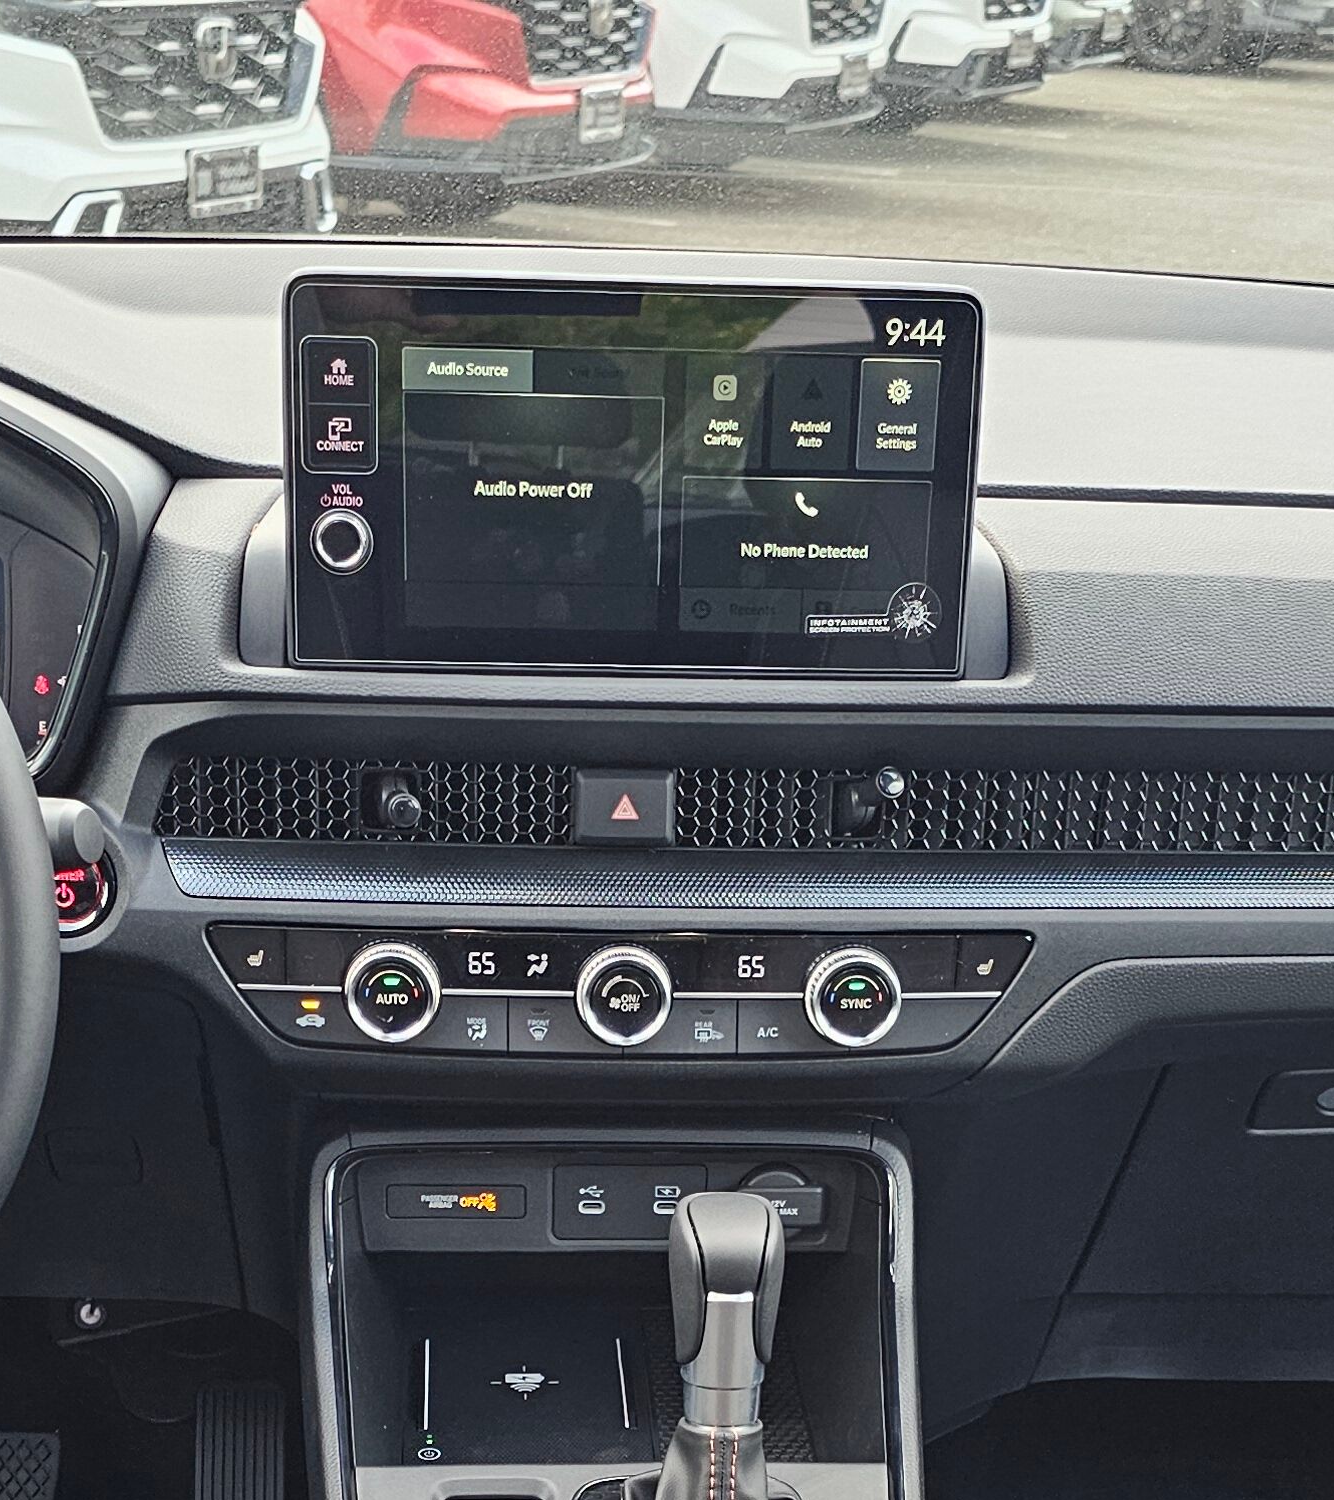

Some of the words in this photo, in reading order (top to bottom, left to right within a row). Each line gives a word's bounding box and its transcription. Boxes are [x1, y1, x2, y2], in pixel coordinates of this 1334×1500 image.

[885, 317, 946, 347] 9:44
[427, 361, 464, 376] Audio
[465, 362, 509, 377] Source
[324, 374, 354, 386] HOME
[708, 418, 739, 433] Apple
[790, 420, 831, 434] Android
[877, 422, 917, 436] General
[316, 440, 364, 452] CONNECT
[703, 433, 744, 448] CarPlay
[796, 434, 823, 448] Auto
[876, 436, 917, 451] Settings
[331, 484, 353, 495] VOL
[474, 480, 516, 497] Audio
[519, 482, 565, 498] Power
[567, 482, 593, 498] Off
[332, 496, 363, 507] AUDIO
[740, 542, 761, 558] No
[763, 543, 805, 558] Phone
[808, 544, 869, 559] Detected
[809, 618, 890, 627] INFOTAINMENT
[468, 952, 495, 975] 65
[737, 955, 765, 978] 65
[376, 993, 409, 1005] AUTO
[621, 994, 641, 1004] ON/
[840, 998, 872, 1009] SYNC
[621, 1003, 640, 1012] OFF
[527, 1019, 551, 1027] FRONT
[757, 1027, 779, 1038] A/C
[459, 1196, 480, 1208] OFF
[779, 1207, 798, 1216] MAX
